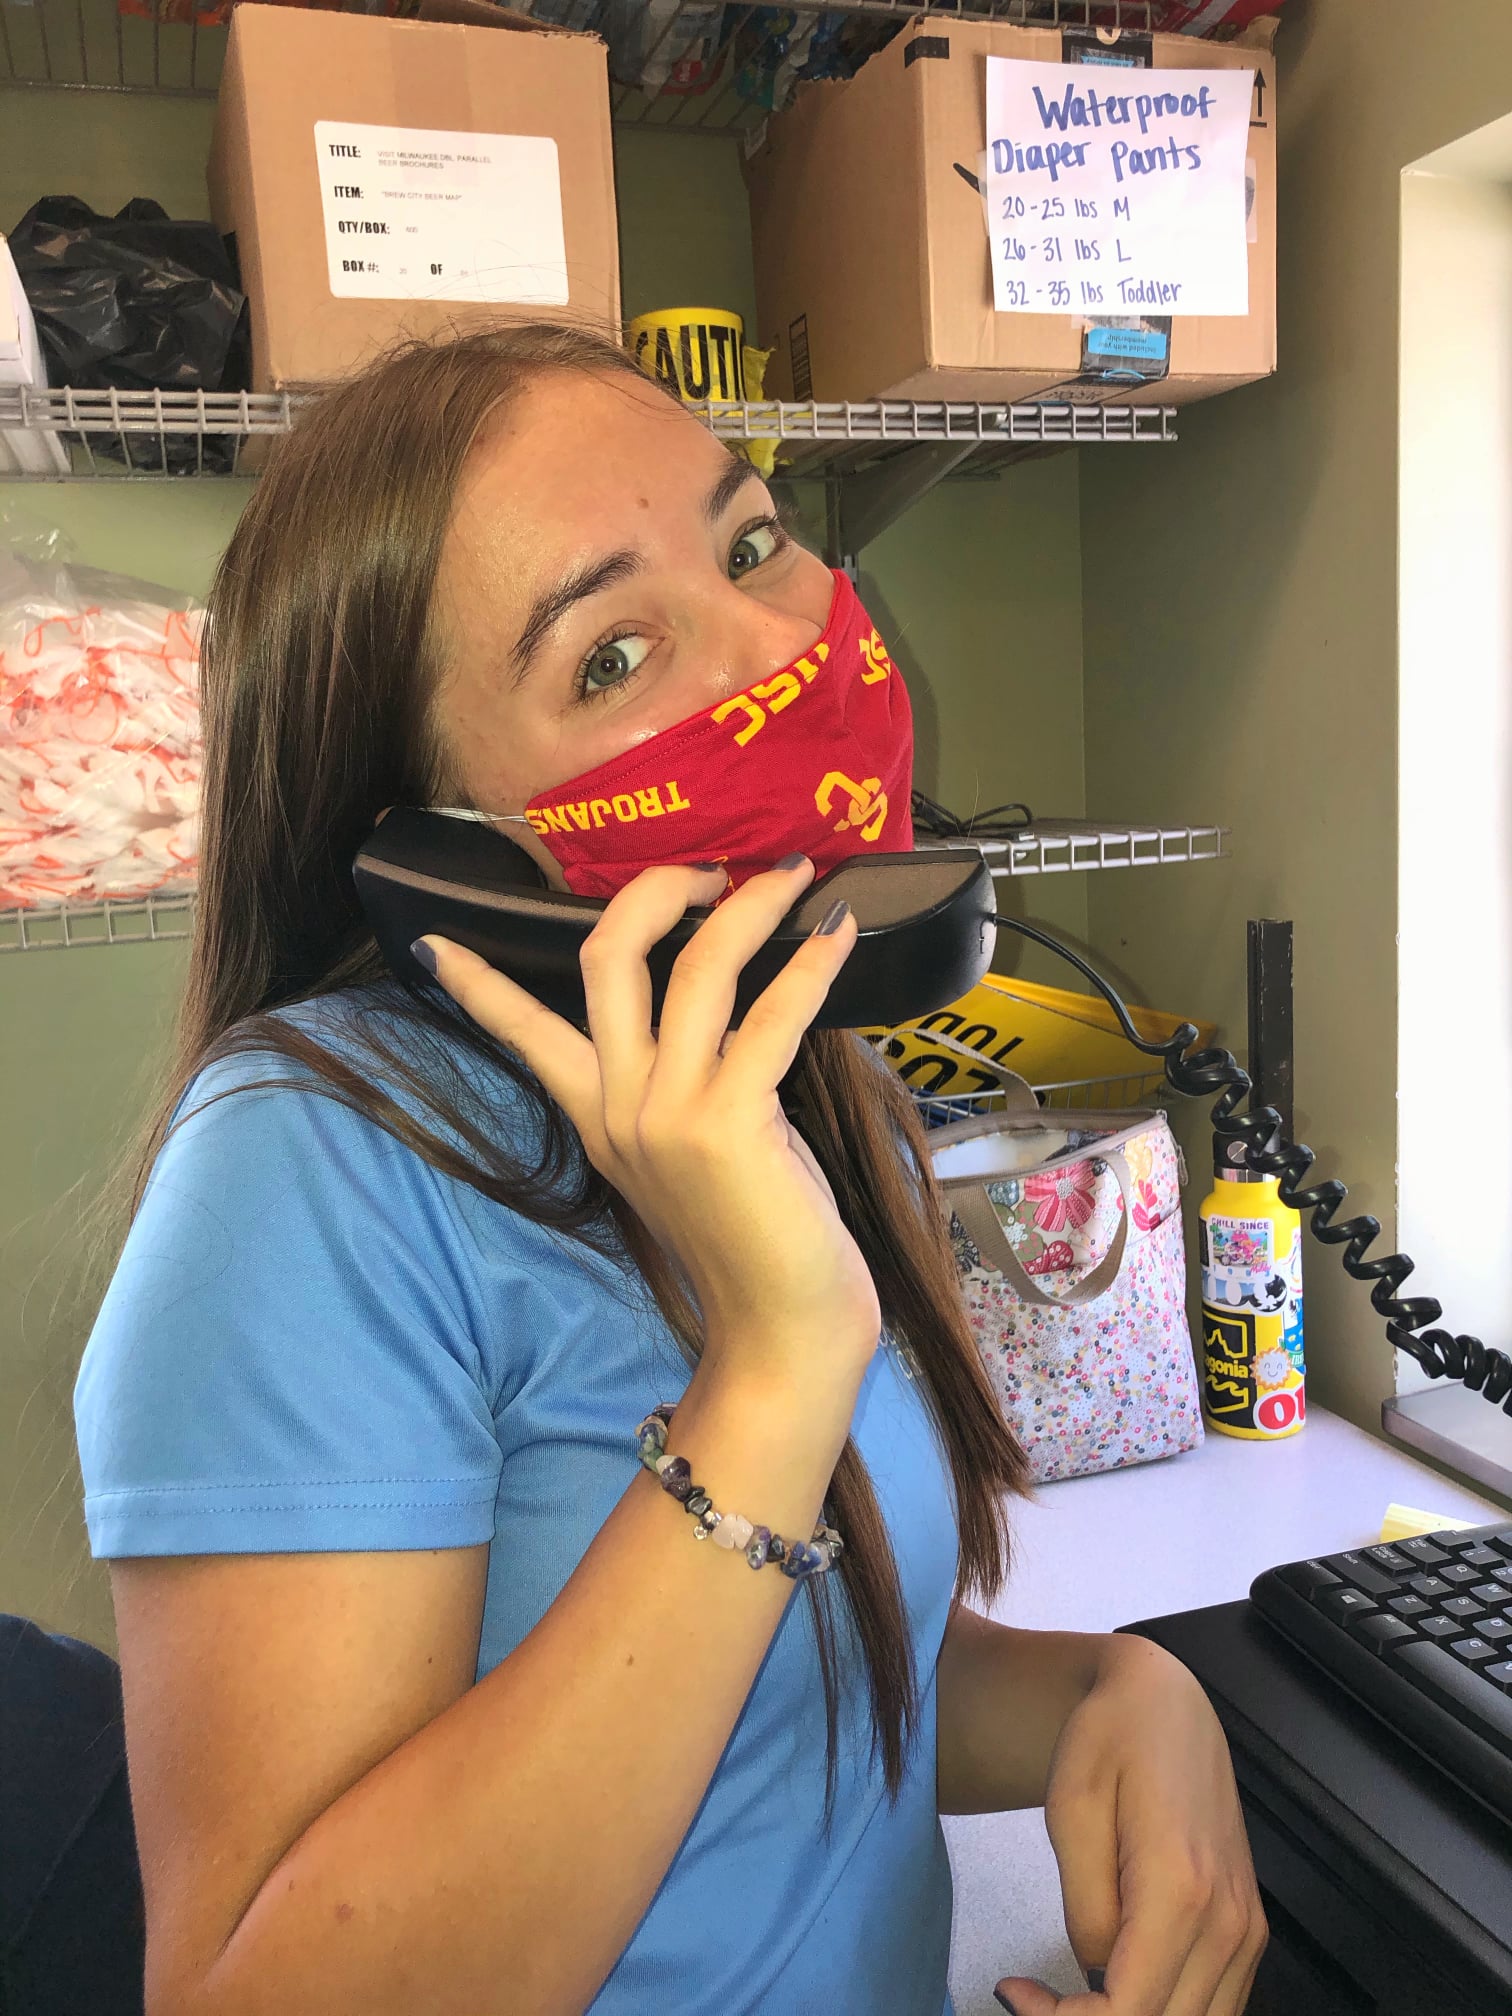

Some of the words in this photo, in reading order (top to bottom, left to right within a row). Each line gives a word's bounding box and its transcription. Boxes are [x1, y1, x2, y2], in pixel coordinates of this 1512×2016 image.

[1031, 82, 1217, 135] Waterproof
[328, 144, 361, 159] TITLE:
[991, 137, 1092, 182] Diaper
[1110, 135, 1202, 183] Pants
[333, 185, 364, 199] ITEM:
[1074, 198, 1098, 219] lbs
[1113, 195, 1131, 222] M
[337, 219, 391, 235] QTY/BOX:
[1074, 238, 1101, 261] lbs
[1115, 238, 1132, 263] L
[342, 259, 365, 272] BOX
[430, 263, 443, 276] OF
[1080, 280, 1104, 304] lbs
[1117, 276, 1182, 306] Toddler
[635, 324, 748, 401] CAUTI
[523, 780, 692, 836] TROJANS
[1239, 1221, 1270, 1230] SINCE
[1456, 1565, 1468, 1574] Q
[1434, 1617, 1449, 1625] X
[1469, 1640, 1482, 1648] C
